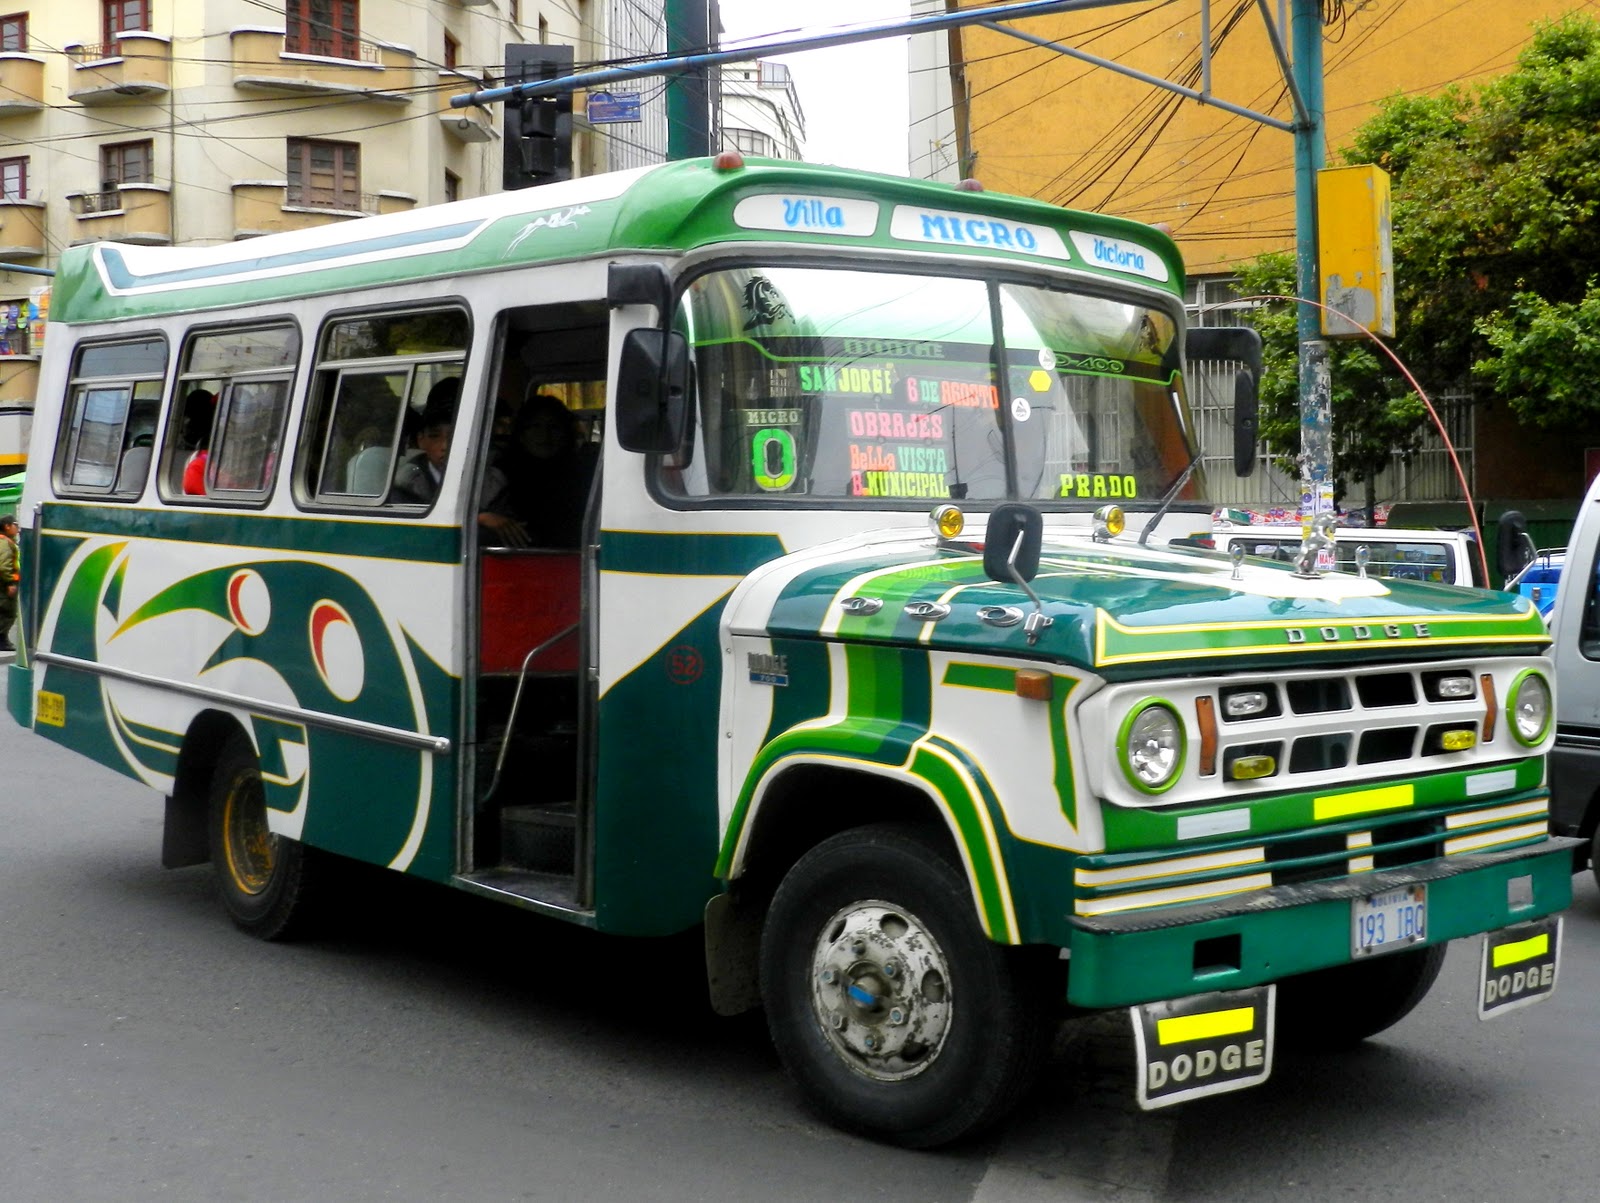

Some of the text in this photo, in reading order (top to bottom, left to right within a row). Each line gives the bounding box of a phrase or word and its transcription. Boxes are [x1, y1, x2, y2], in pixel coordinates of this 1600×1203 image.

[783, 199, 845, 228] Villa
[920, 214, 1037, 252] MICRO
[1094, 239, 1145, 270] Victoria
[800, 366, 837, 392] SAN
[907, 377, 999, 409] 6 DE AGOSTO
[747, 411, 799, 423] MICRO
[850, 411, 943, 438] OBRAJES
[897, 447, 947, 473] VISTA
[1060, 474, 1137, 498] PRADO
[1285, 623, 1430, 643] DODGE
[673, 655, 697, 675] 52
[1359, 912, 1386, 948] 193
[1486, 963, 1554, 1003] DODGE
[1148, 1039, 1264, 1090] DODGE
